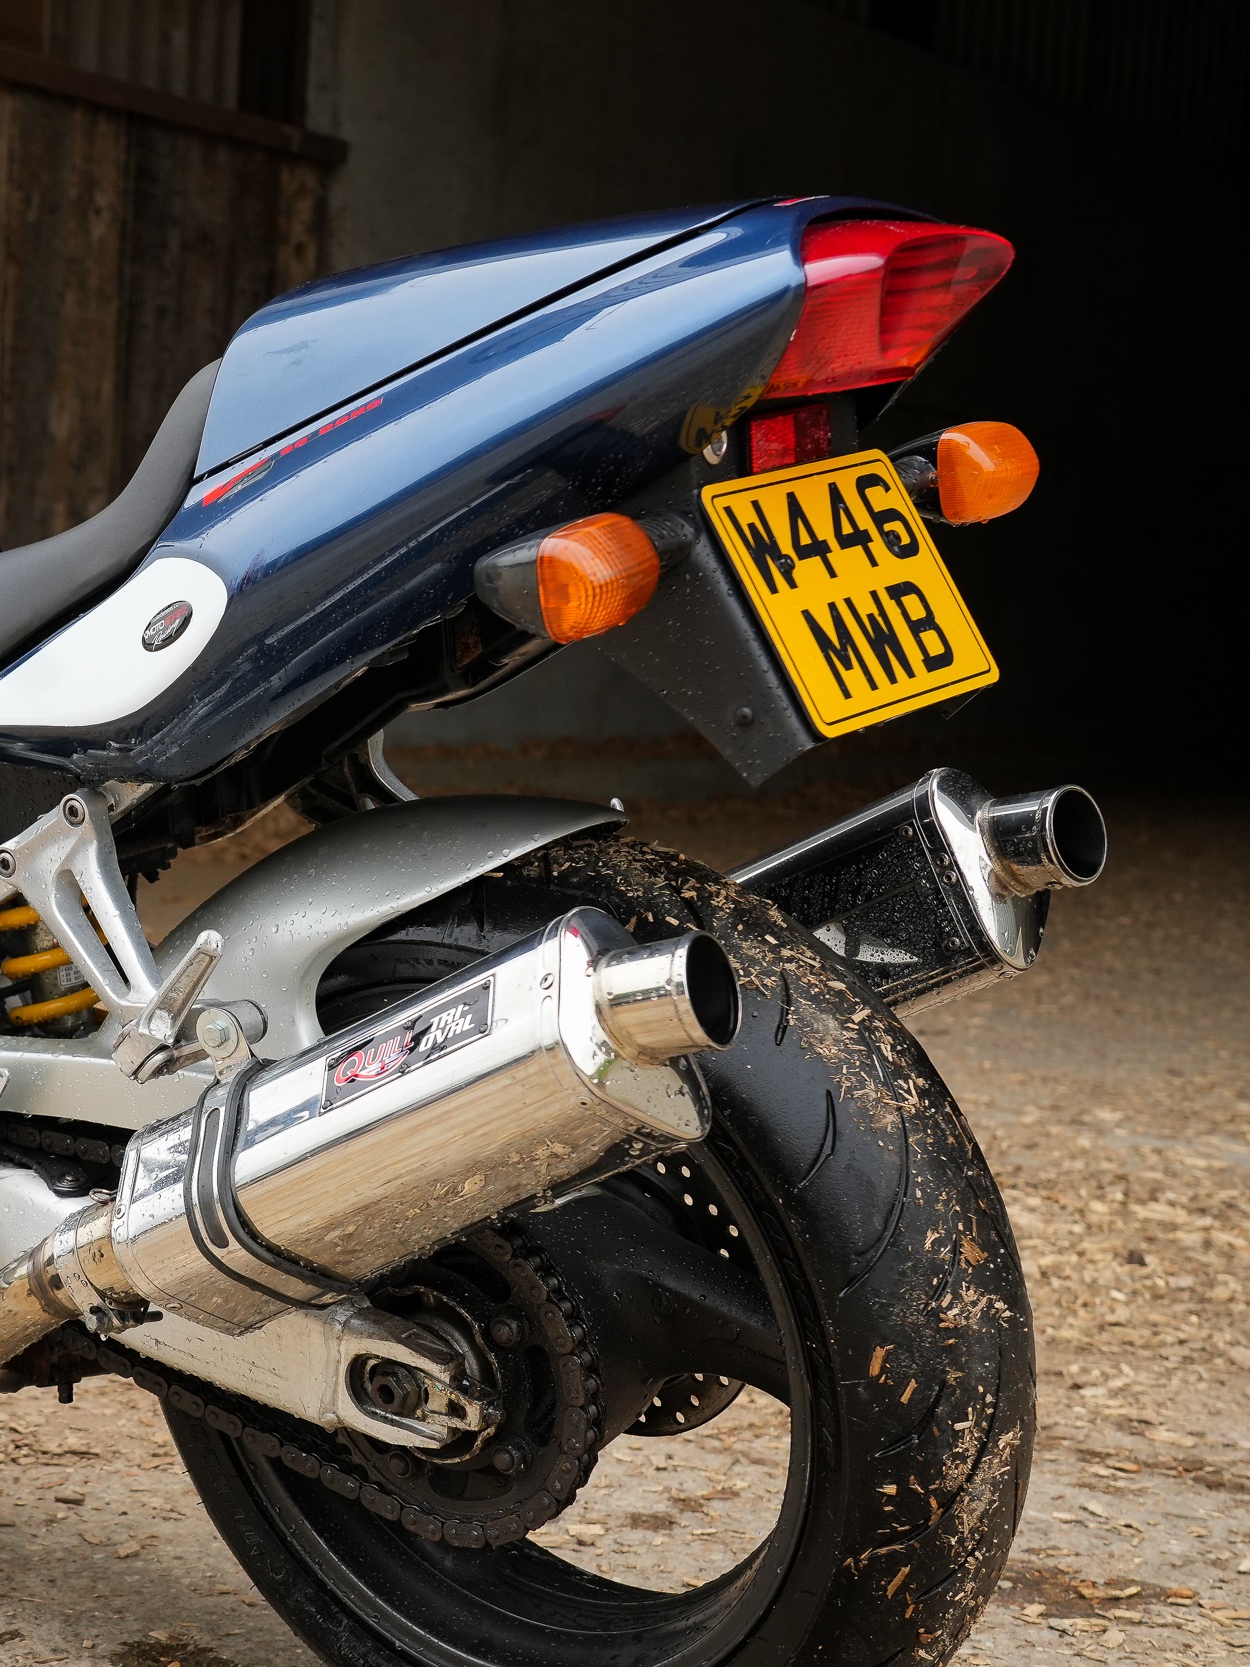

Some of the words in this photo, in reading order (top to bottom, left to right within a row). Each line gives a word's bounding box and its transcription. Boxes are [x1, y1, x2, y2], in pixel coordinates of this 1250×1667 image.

[722, 472, 920, 595] W446
[801, 579, 954, 701] MWB
[419, 1014, 476, 1052] OVAL
[430, 1004, 469, 1032] TRI-
[334, 1030, 414, 1086] QUILL
